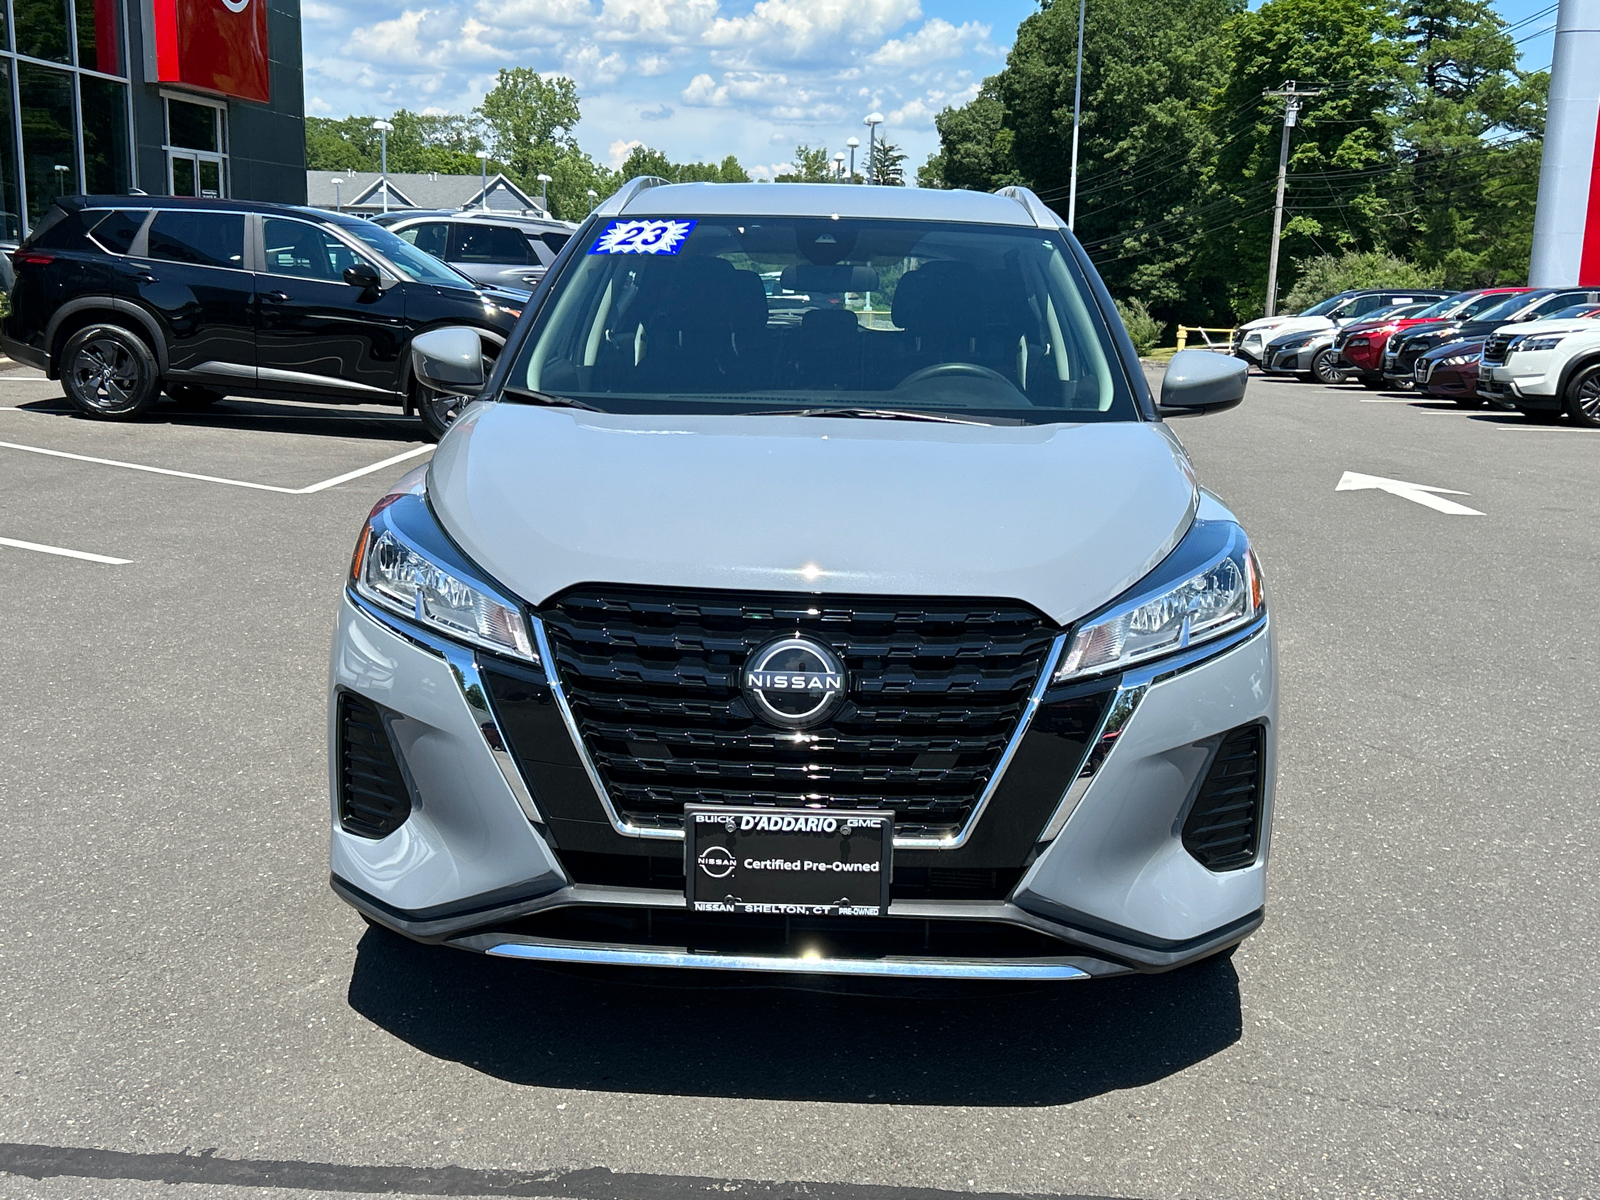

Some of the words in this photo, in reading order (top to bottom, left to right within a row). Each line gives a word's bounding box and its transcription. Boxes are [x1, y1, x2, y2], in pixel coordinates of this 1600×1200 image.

[614, 226, 669, 246] 23
[748, 673, 841, 689] NISSAN
[696, 815, 735, 823] BUICK
[741, 816, 837, 832] D'ADDARIO
[847, 819, 882, 828] GMC
[698, 858, 737, 866] NISSAN
[744, 858, 801, 870] Certified
[803, 860, 880, 872] Pre-Owned
[694, 903, 735, 912] NISSAN
[744, 905, 810, 915] SHELTON,
[812, 906, 832, 915] CT
[838, 907, 880, 916] PRE-OWNED
